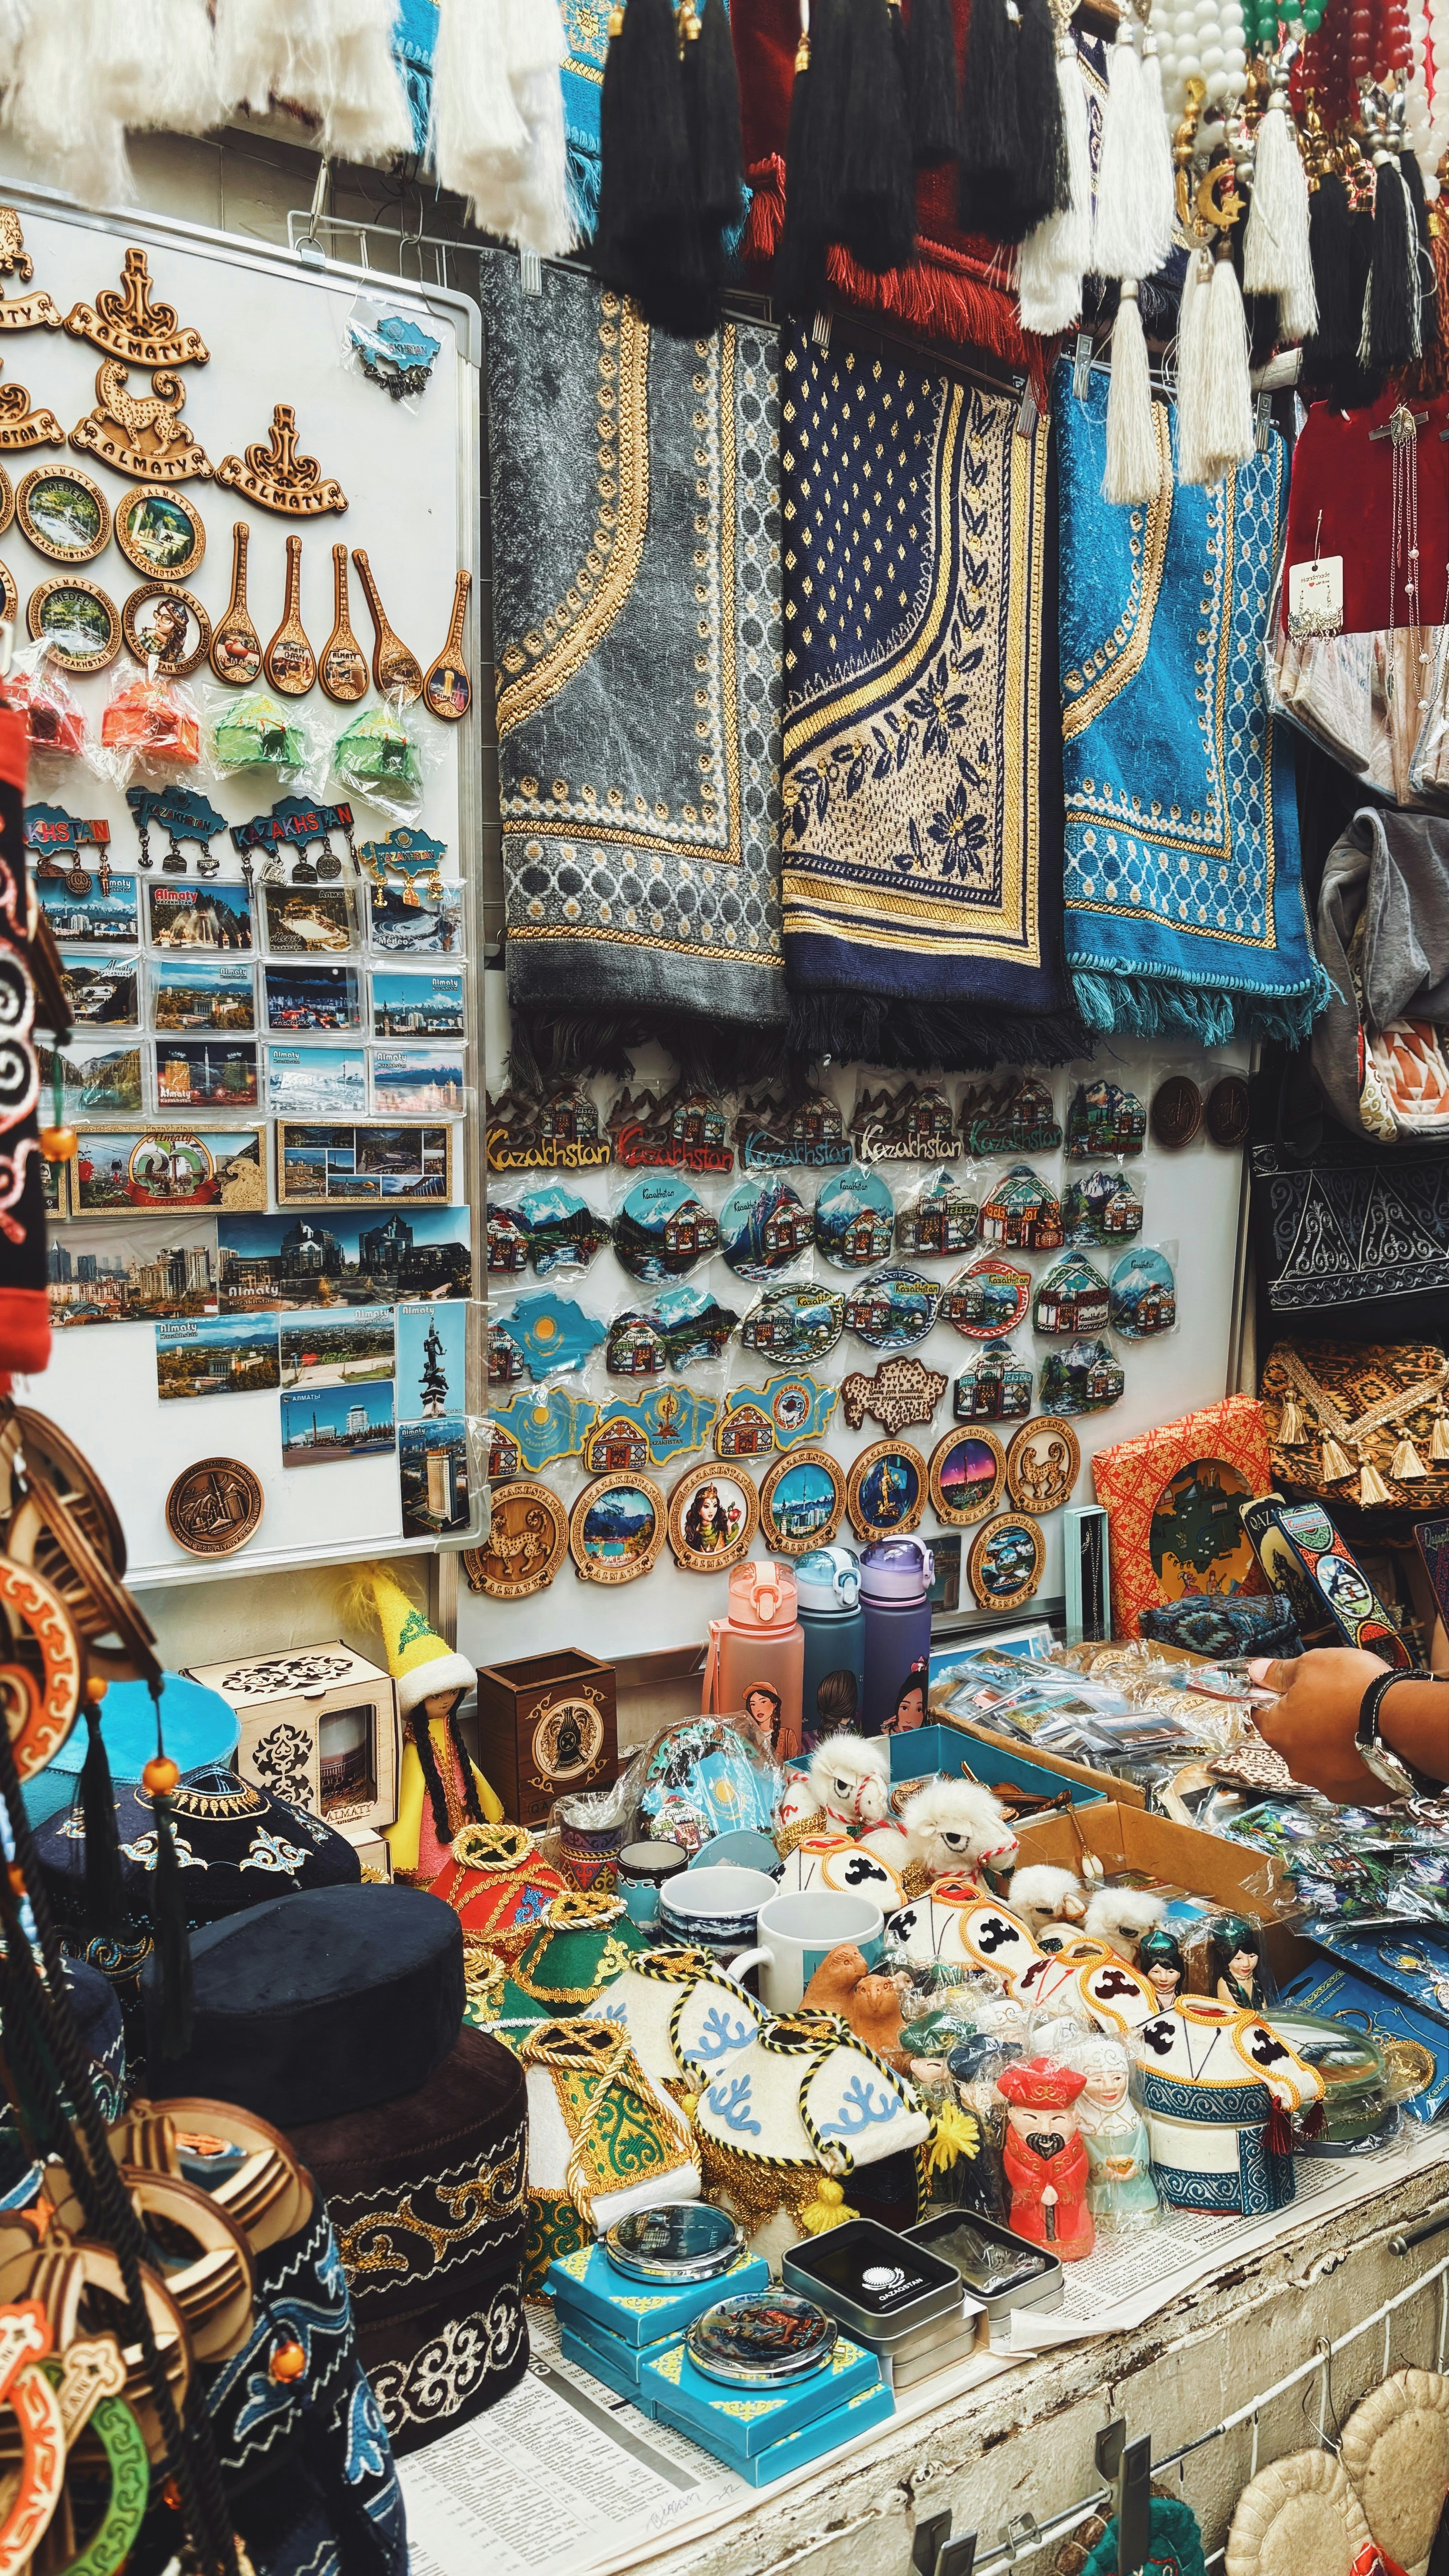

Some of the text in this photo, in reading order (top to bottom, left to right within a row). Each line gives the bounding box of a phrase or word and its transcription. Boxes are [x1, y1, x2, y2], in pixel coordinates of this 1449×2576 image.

[97, 327, 181, 359] ALMATY
[102, 442, 187, 475] ALMATY
[44, 469, 90, 487] ALMATY
[45, 482, 86, 502] MEDEU
[147, 488, 191, 511] ALMATY
[240, 474, 323, 510] ALMATY
[34, 535, 91, 558] KAZAKHSTAN
[129, 548, 182, 577] KAZAKHSTAN
[48, 579, 93, 591] ALMATY
[53, 592, 90, 607] MEDEU
[168, 588, 206, 620] ALMATY
[129, 632, 173, 672] KAZAKTAN
[283, 646, 305, 654] ALMATY
[332, 652, 357, 660] ALMATY
[53, 653, 108, 668] KAZAKHSTAN
[218, 656, 257, 667] ALMATY
[437, 694, 456, 702] ALMATY
[146, 803, 211, 832] KAZAKHSTAN
[235, 806, 352, 846] KAZAKHSTAN
[25, 821, 108, 843] KHSTAN
[378, 850, 434, 862] KAZAKHSTAN
[73, 876, 86, 884] 100
[109, 879, 131, 889] maty
[154, 888, 198, 904] Almaty
[220, 968, 247, 977] Almaty
[432, 978, 458, 988] Almaty
[273, 1050, 300, 1061] Almaty
[377, 1052, 407, 1063] Almaty
[161, 1086, 191, 1099] Almaty
[147, 1132, 193, 1145] Almaty
[860, 1124, 961, 1163] Kazakhstan
[970, 1119, 1063, 1156] Kazakhstan
[486, 1128, 611, 1171] Kazakhstan
[618, 1126, 734, 1173] Kazakhstan
[745, 1132, 853, 1168] Kazakhstan
[643, 1188, 675, 1200] Kazakhstan
[895, 1282, 938, 1293] Kazakhstan
[988, 1274, 1029, 1284] Kazakhstan
[228, 1284, 279, 1298] Almaty
[355, 1309, 389, 1319] Almaty
[402, 1306, 435, 1316] Almaty
[160, 1323, 198, 1333] Almaty
[402, 1428, 425, 1436] Almaty
[649, 1438, 683, 1446] AZAKHSTAN
[942, 1429, 994, 1454] KAZAKHSTAN
[861, 1444, 918, 1470] KAZAKHSTAN
[777, 1454, 835, 1479] KAZAKHSTAN
[589, 1475, 658, 1502] KAZAKHSTAN
[685, 1467, 747, 1493] KAZAKHSTAN
[491, 1486, 558, 1510] AZAKHSTAN
[1025, 1497, 1061, 1512] ALMATY
[952, 1504, 991, 1523] ALMATY
[785, 1536, 827, 1551] ALMATY
[616, 1552, 632, 1562] Lake
[692, 1551, 737, 1568] ALMATY
[595, 1565, 641, 1580] ALMATY
[489, 1578, 539, 1595] ALMATY
[992, 1590, 1029, 1609] ALMATY
[327, 1803, 373, 1822] ALMATY
[1320, 1982, 1346, 2008] Kazakhstan
[1426, 2074, 1449, 2100] Kazakh
[879, 2277, 923, 2301] QAZAQSTAN
